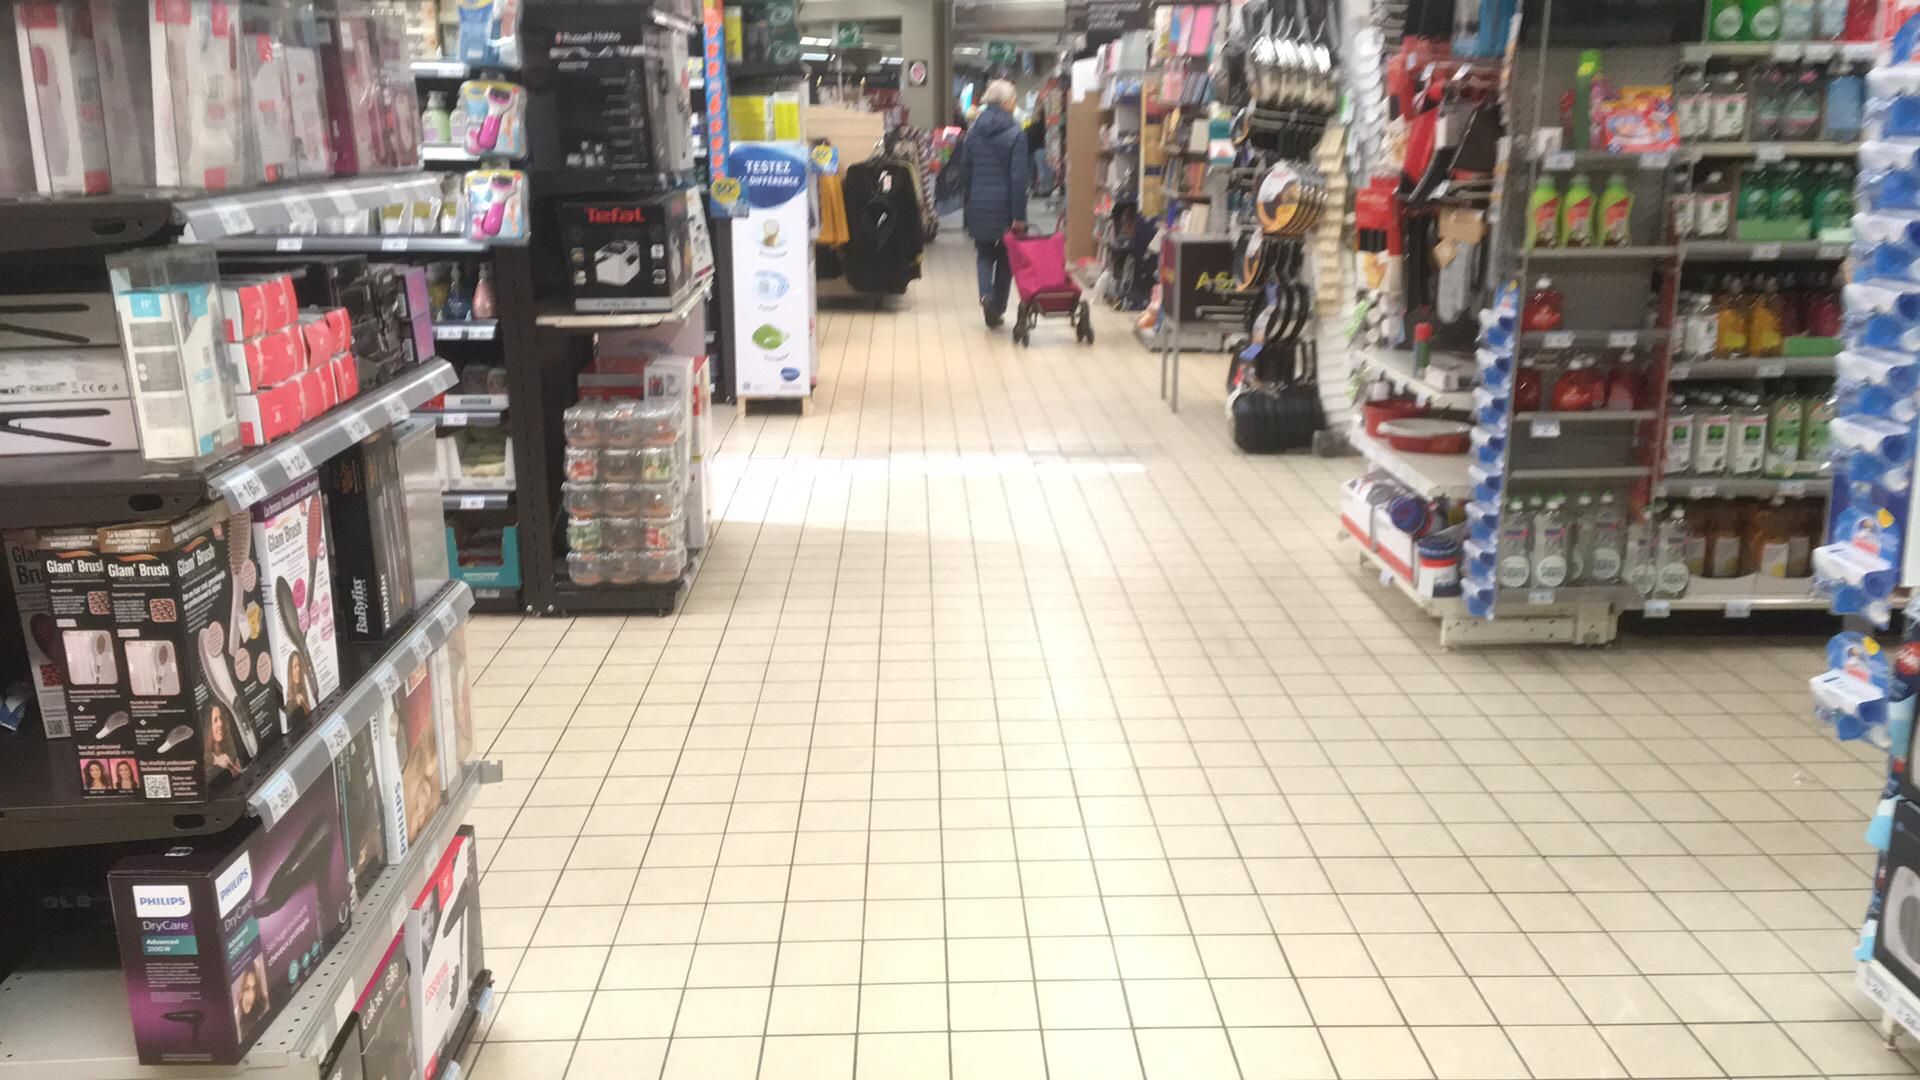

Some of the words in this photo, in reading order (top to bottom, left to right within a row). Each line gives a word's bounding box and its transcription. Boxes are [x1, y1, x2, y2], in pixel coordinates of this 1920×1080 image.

[744, 159, 793, 175] TESTEZ
[585, 207, 646, 224] Tefal
[46, 560, 75, 574] Glam'
[176, 552, 195, 578] Glam'
[196, 543, 216, 567] Brush
[108, 563, 136, 578] Glam'
[139, 563, 170, 577] Brush
[353, 577, 369, 634] BaByliss
[220, 867, 249, 902] PHILIPS
[139, 896, 186, 906] PHILIPS
[224, 899, 253, 932] DryCare
[142, 920, 189, 932] DryCare
